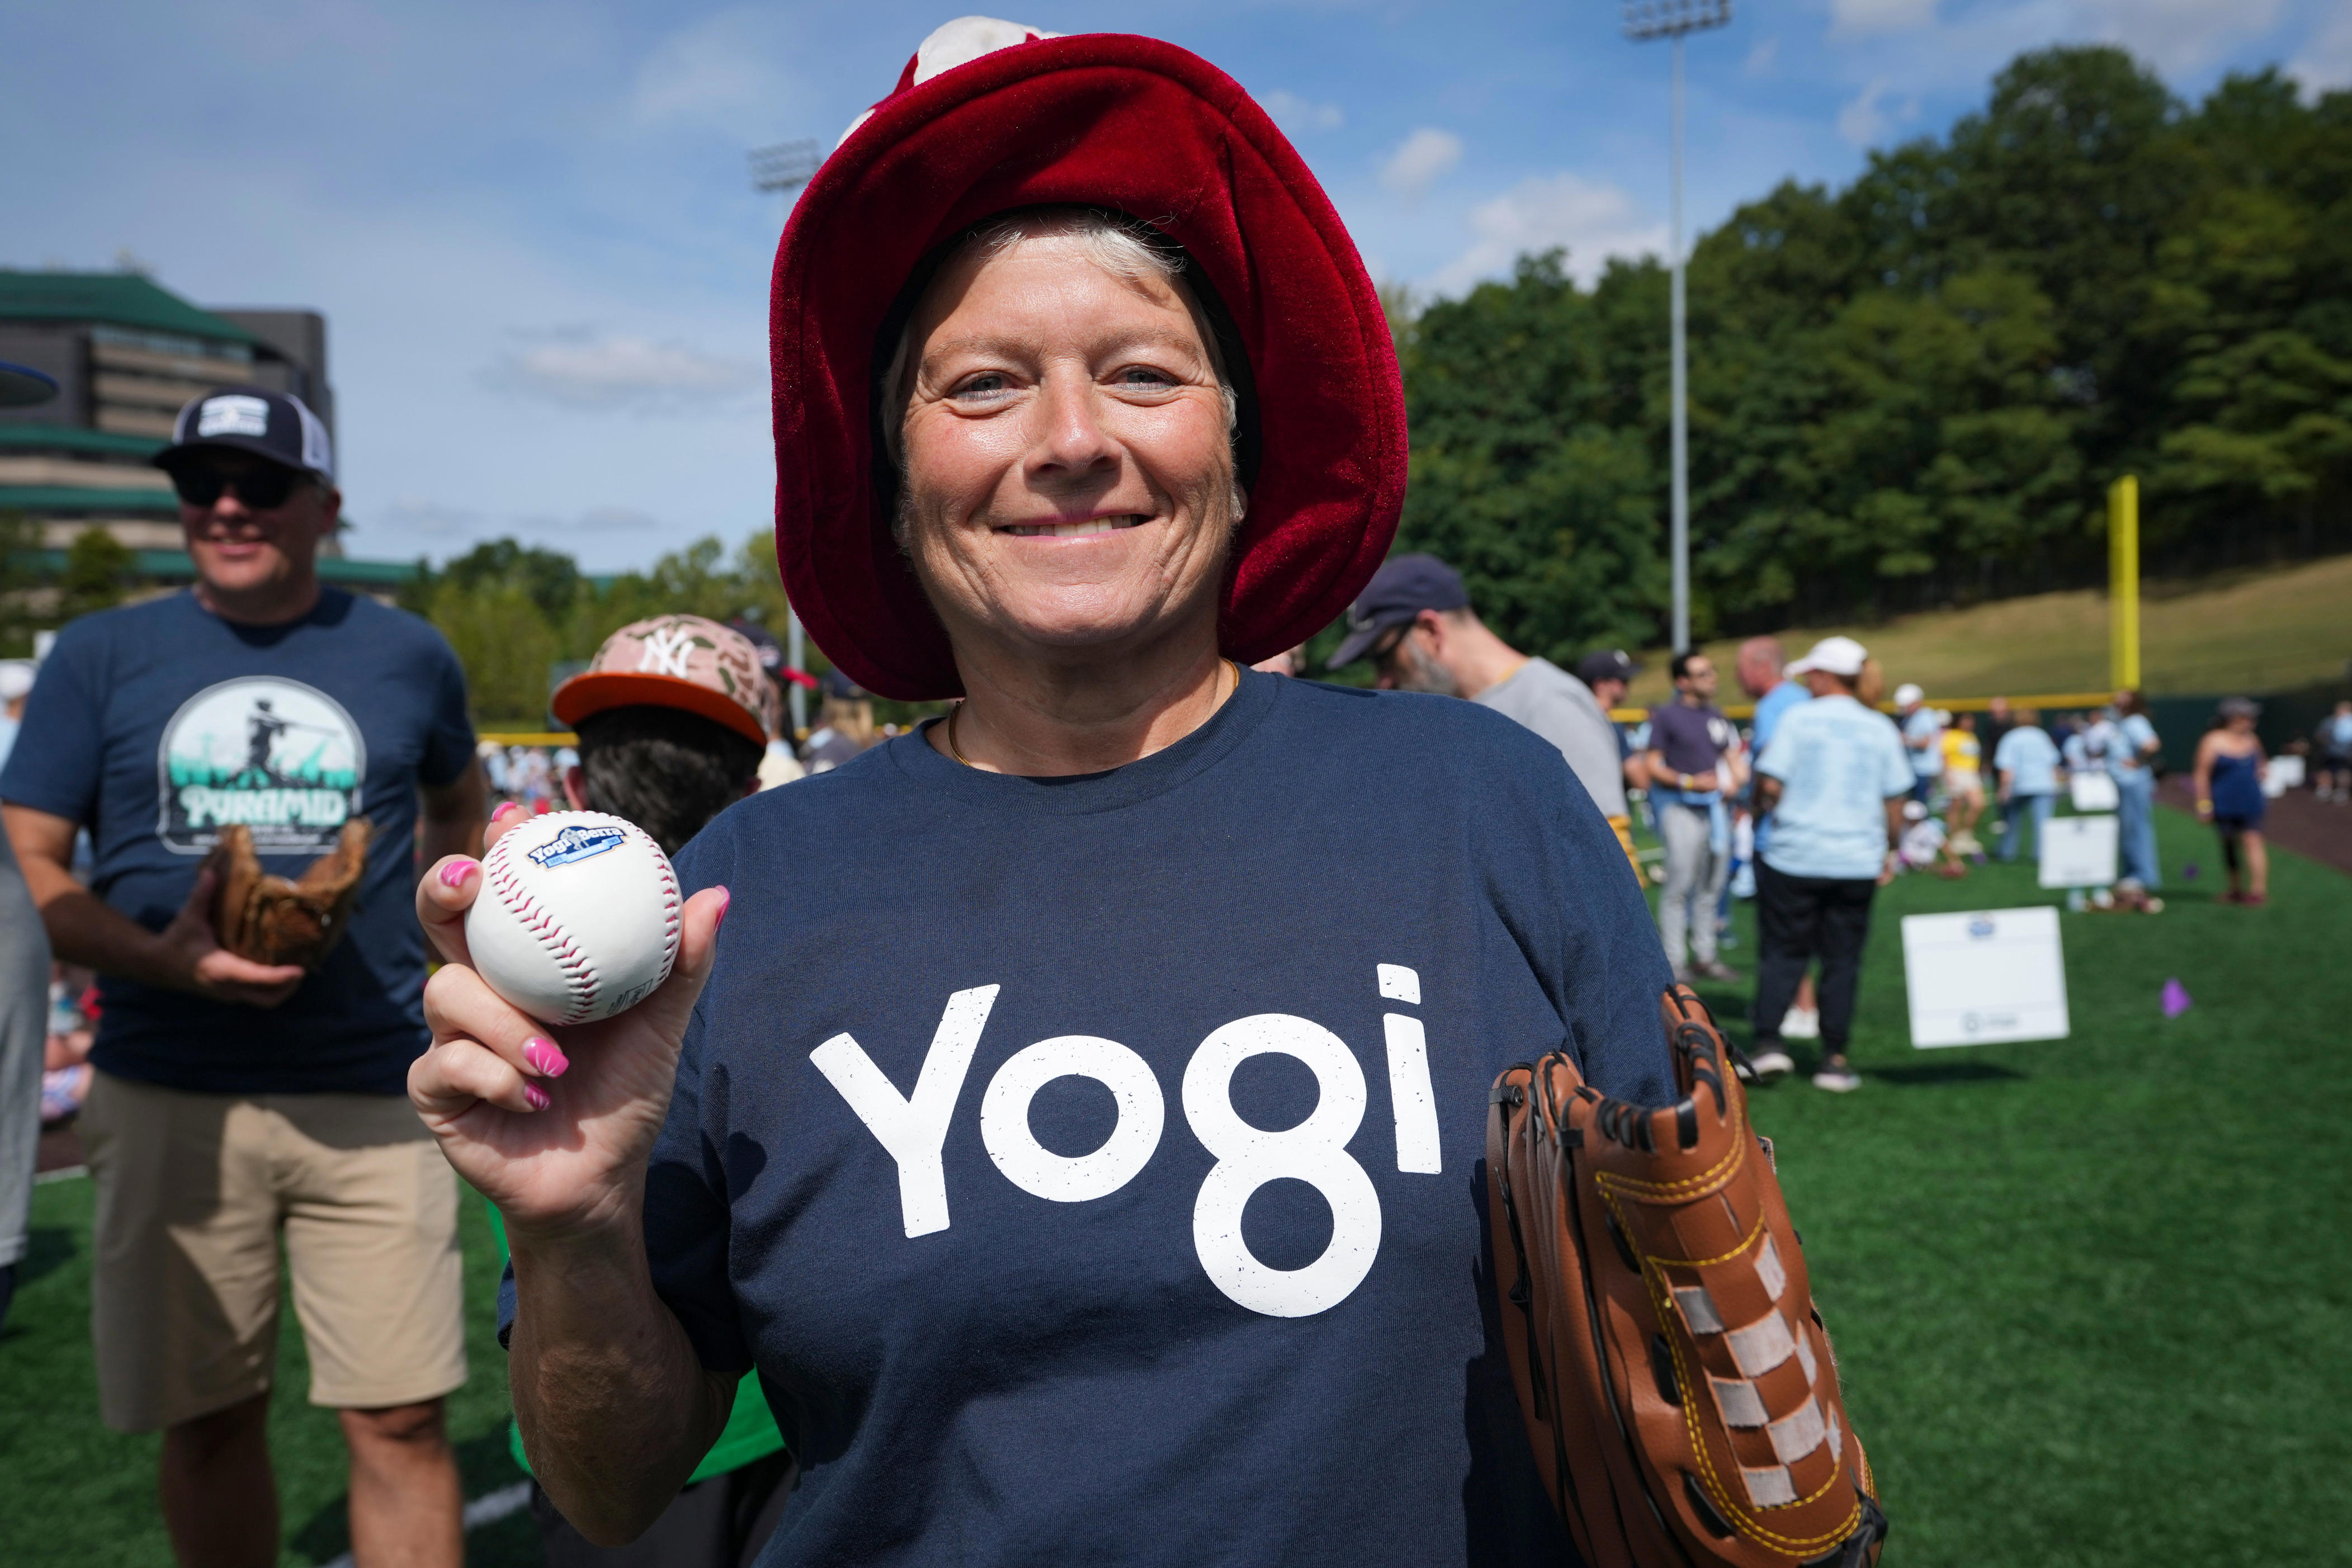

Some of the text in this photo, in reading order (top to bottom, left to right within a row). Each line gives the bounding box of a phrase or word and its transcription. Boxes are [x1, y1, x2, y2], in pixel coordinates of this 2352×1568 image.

[638, 627, 696, 679] NY
[530, 838, 573, 862] Yogi
[577, 827, 624, 841] Berra
[809, 963, 1442, 1317] Yogi
